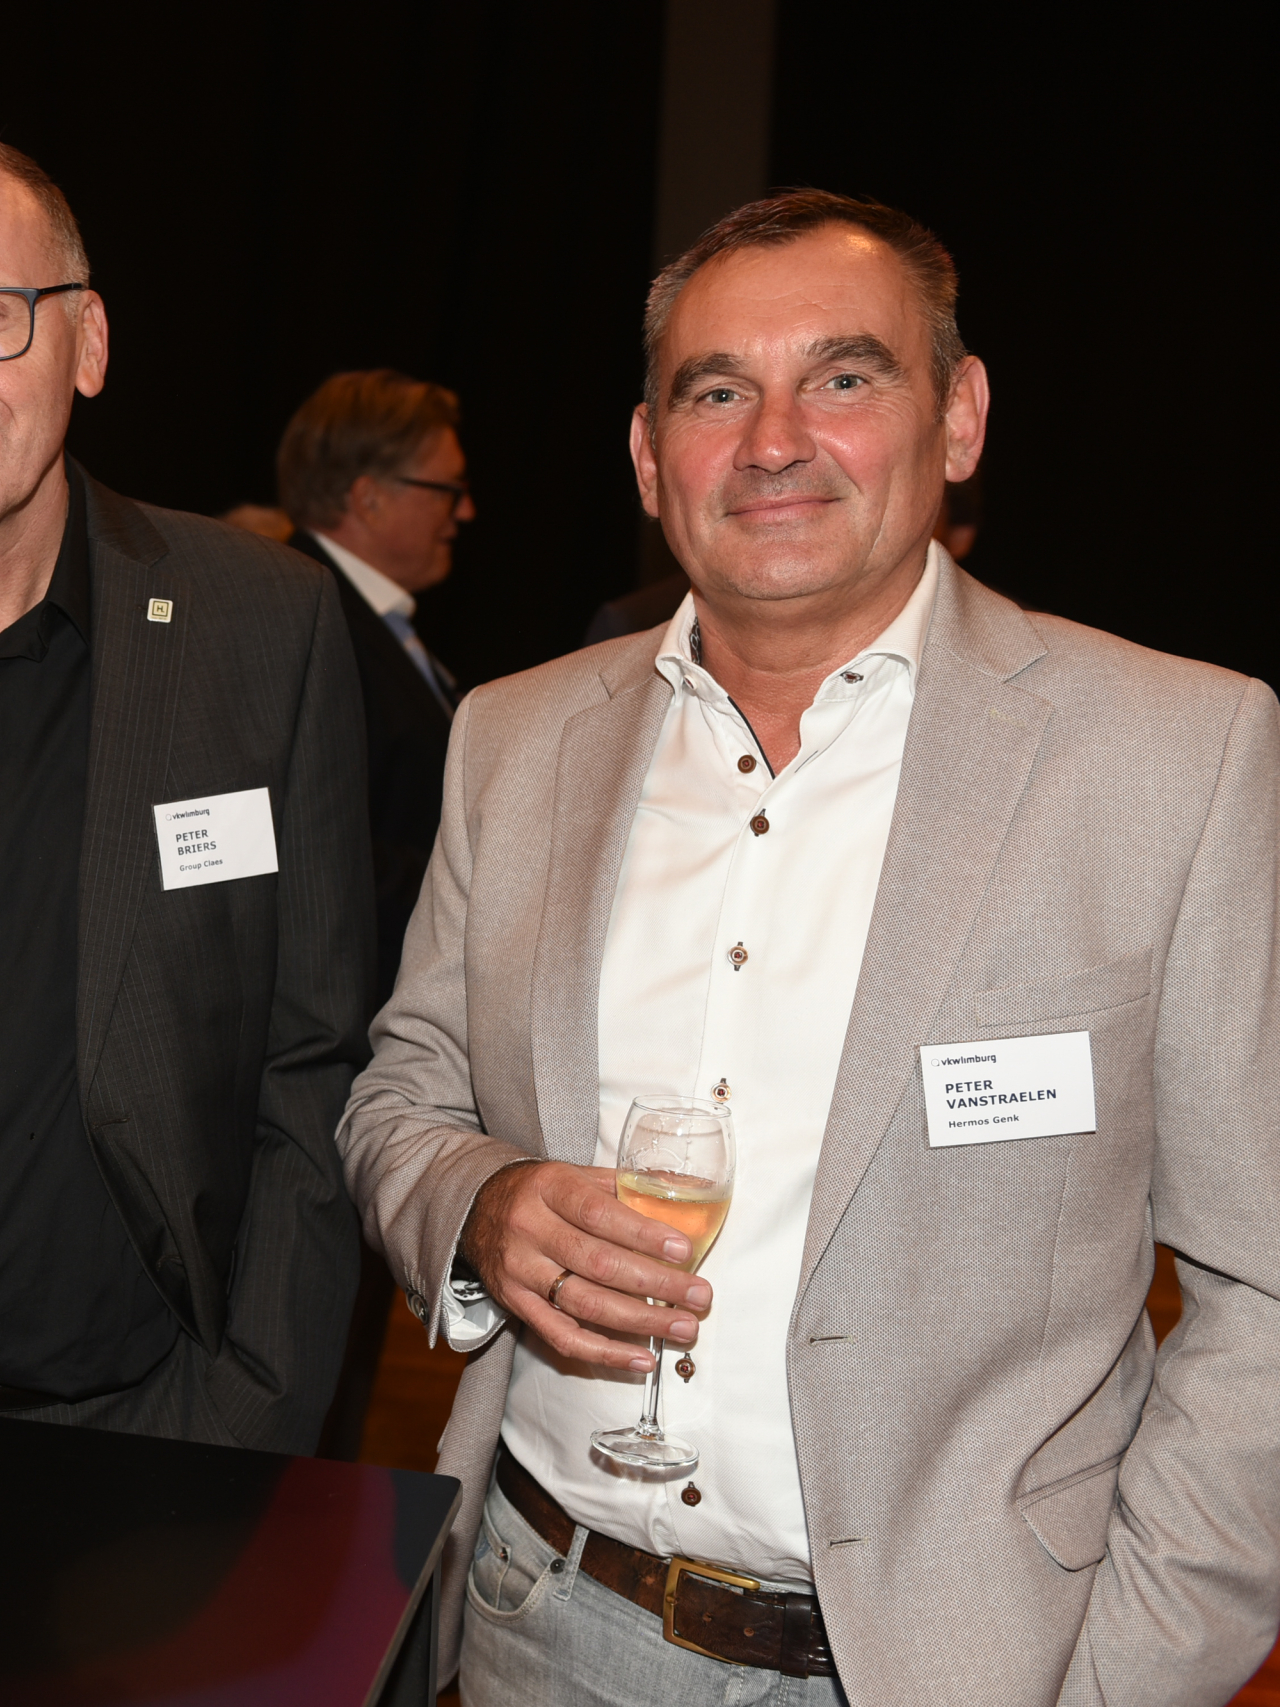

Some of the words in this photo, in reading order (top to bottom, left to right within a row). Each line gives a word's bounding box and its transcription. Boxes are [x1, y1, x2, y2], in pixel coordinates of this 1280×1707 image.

[172, 808, 210, 820] vkwlimburg
[175, 829, 209, 842] PETER
[177, 841, 217, 856] BRIERS
[179, 861, 202, 872] Group
[204, 858, 223, 868] Claes
[941, 1054, 997, 1066] vkwlimburg
[945, 1080, 994, 1094] PETER
[946, 1089, 1057, 1110] VANSTRAELEN
[948, 1118, 989, 1128] Hermos
[993, 1114, 1020, 1124] Genk
